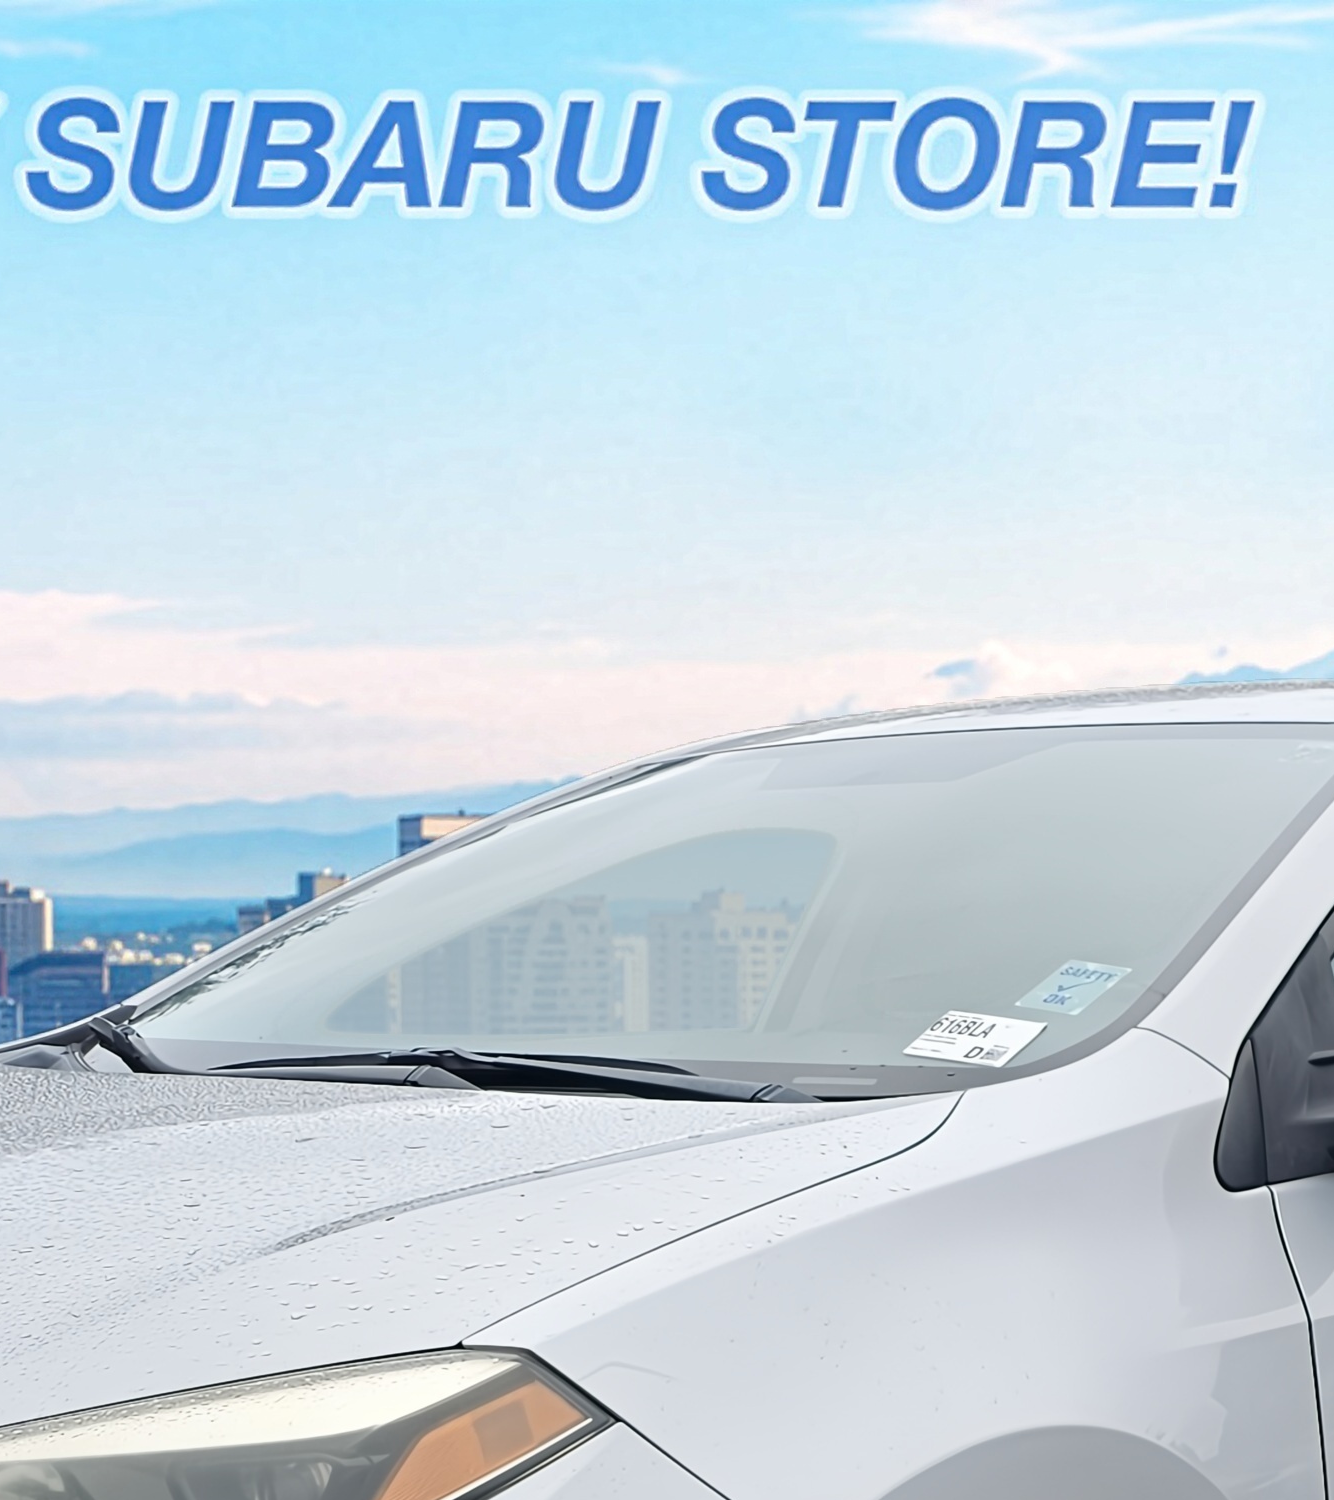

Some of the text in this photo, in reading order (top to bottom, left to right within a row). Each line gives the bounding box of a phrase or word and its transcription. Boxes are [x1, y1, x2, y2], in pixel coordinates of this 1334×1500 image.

[1059, 966, 1119, 983] SAFETY
[1042, 993, 1072, 1006] OK
[963, 1046, 984, 1059] D
